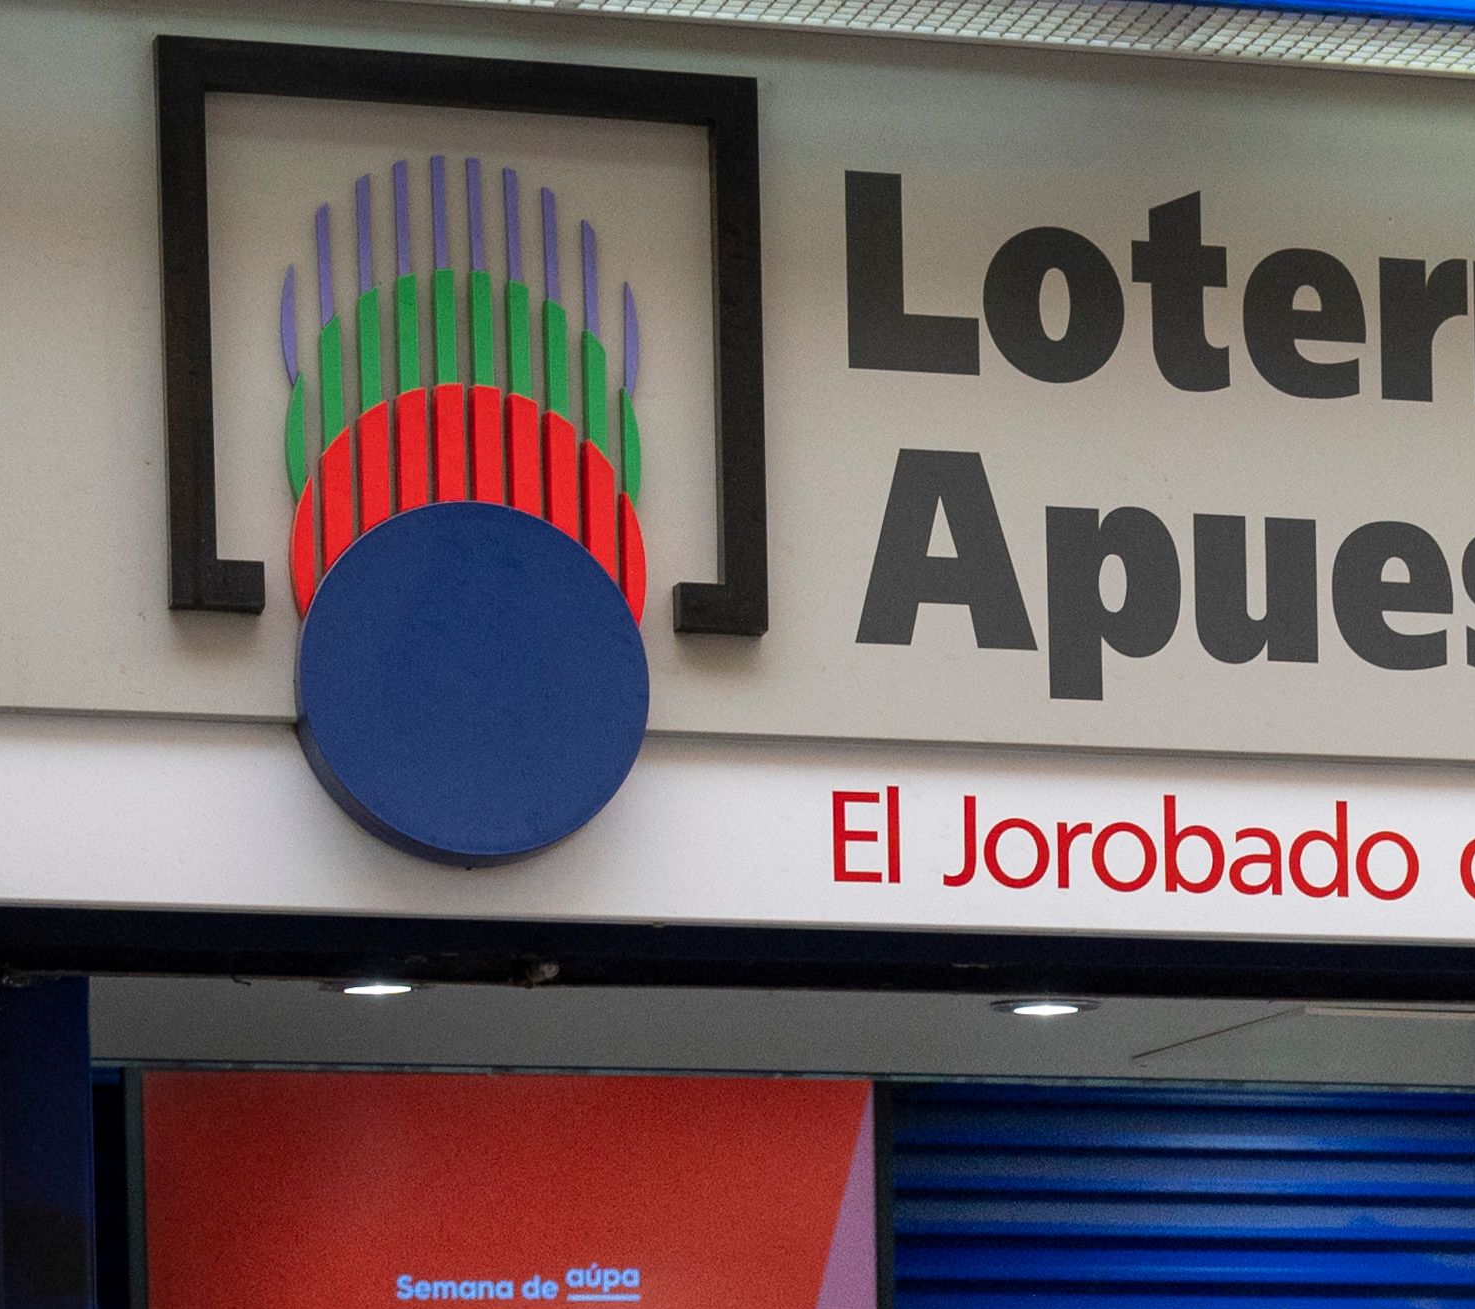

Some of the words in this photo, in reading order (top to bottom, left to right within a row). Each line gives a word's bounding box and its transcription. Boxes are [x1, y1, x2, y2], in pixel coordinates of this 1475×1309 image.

[830, 786, 902, 887] El
[941, 790, 1423, 911] Jorobado
[395, 1274, 514, 1300] Semana
[520, 1274, 559, 1300] de
[565, 1261, 641, 1294] aúpa
